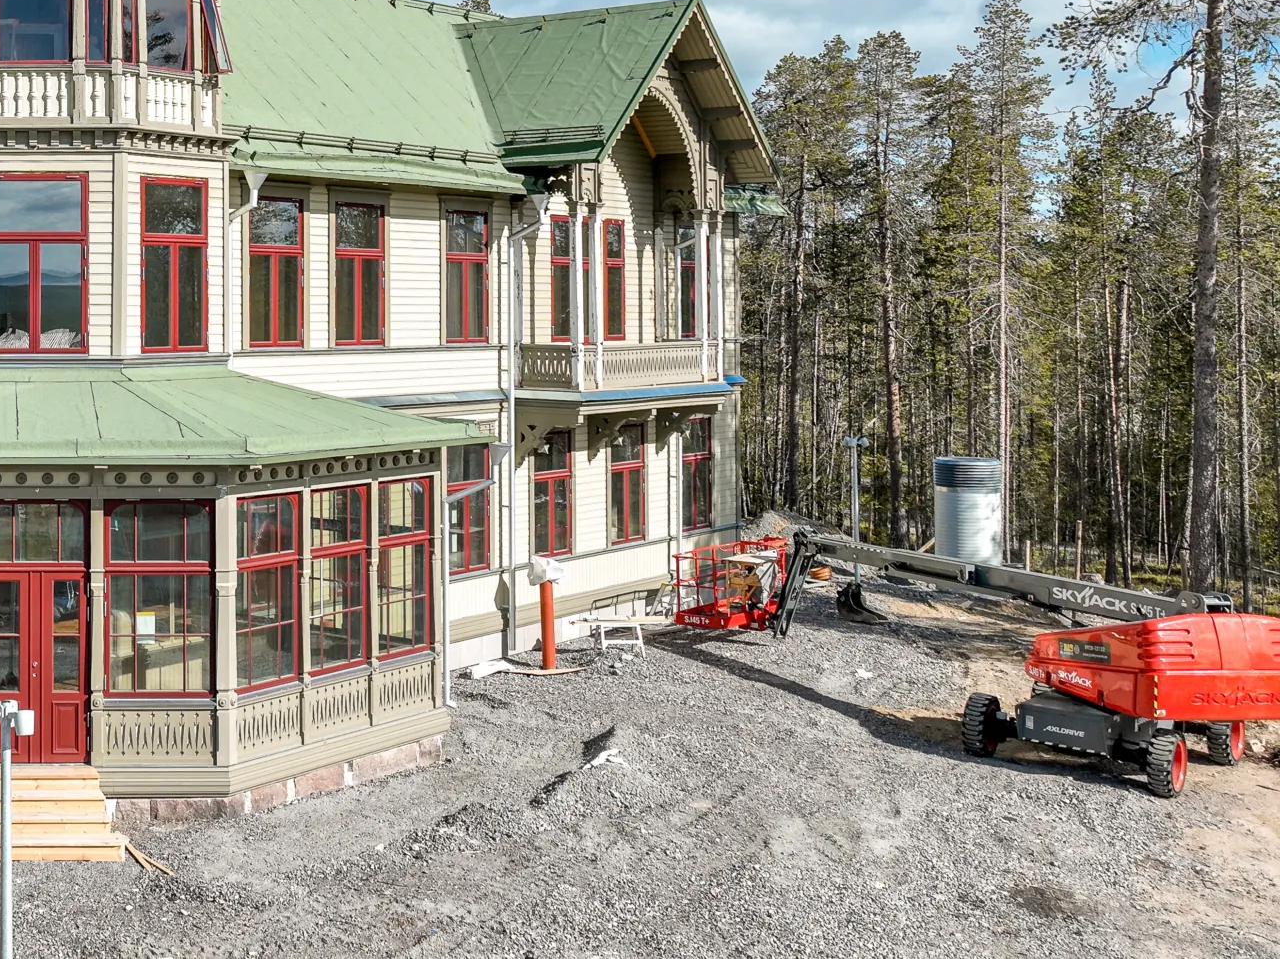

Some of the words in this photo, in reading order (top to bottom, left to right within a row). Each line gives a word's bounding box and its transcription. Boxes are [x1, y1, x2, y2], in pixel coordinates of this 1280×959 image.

[1052, 586, 1129, 613] SKYJACK
[1057, 670, 1093, 688] SKYJACK
[1043, 725, 1085, 738] AXLDRIVE
